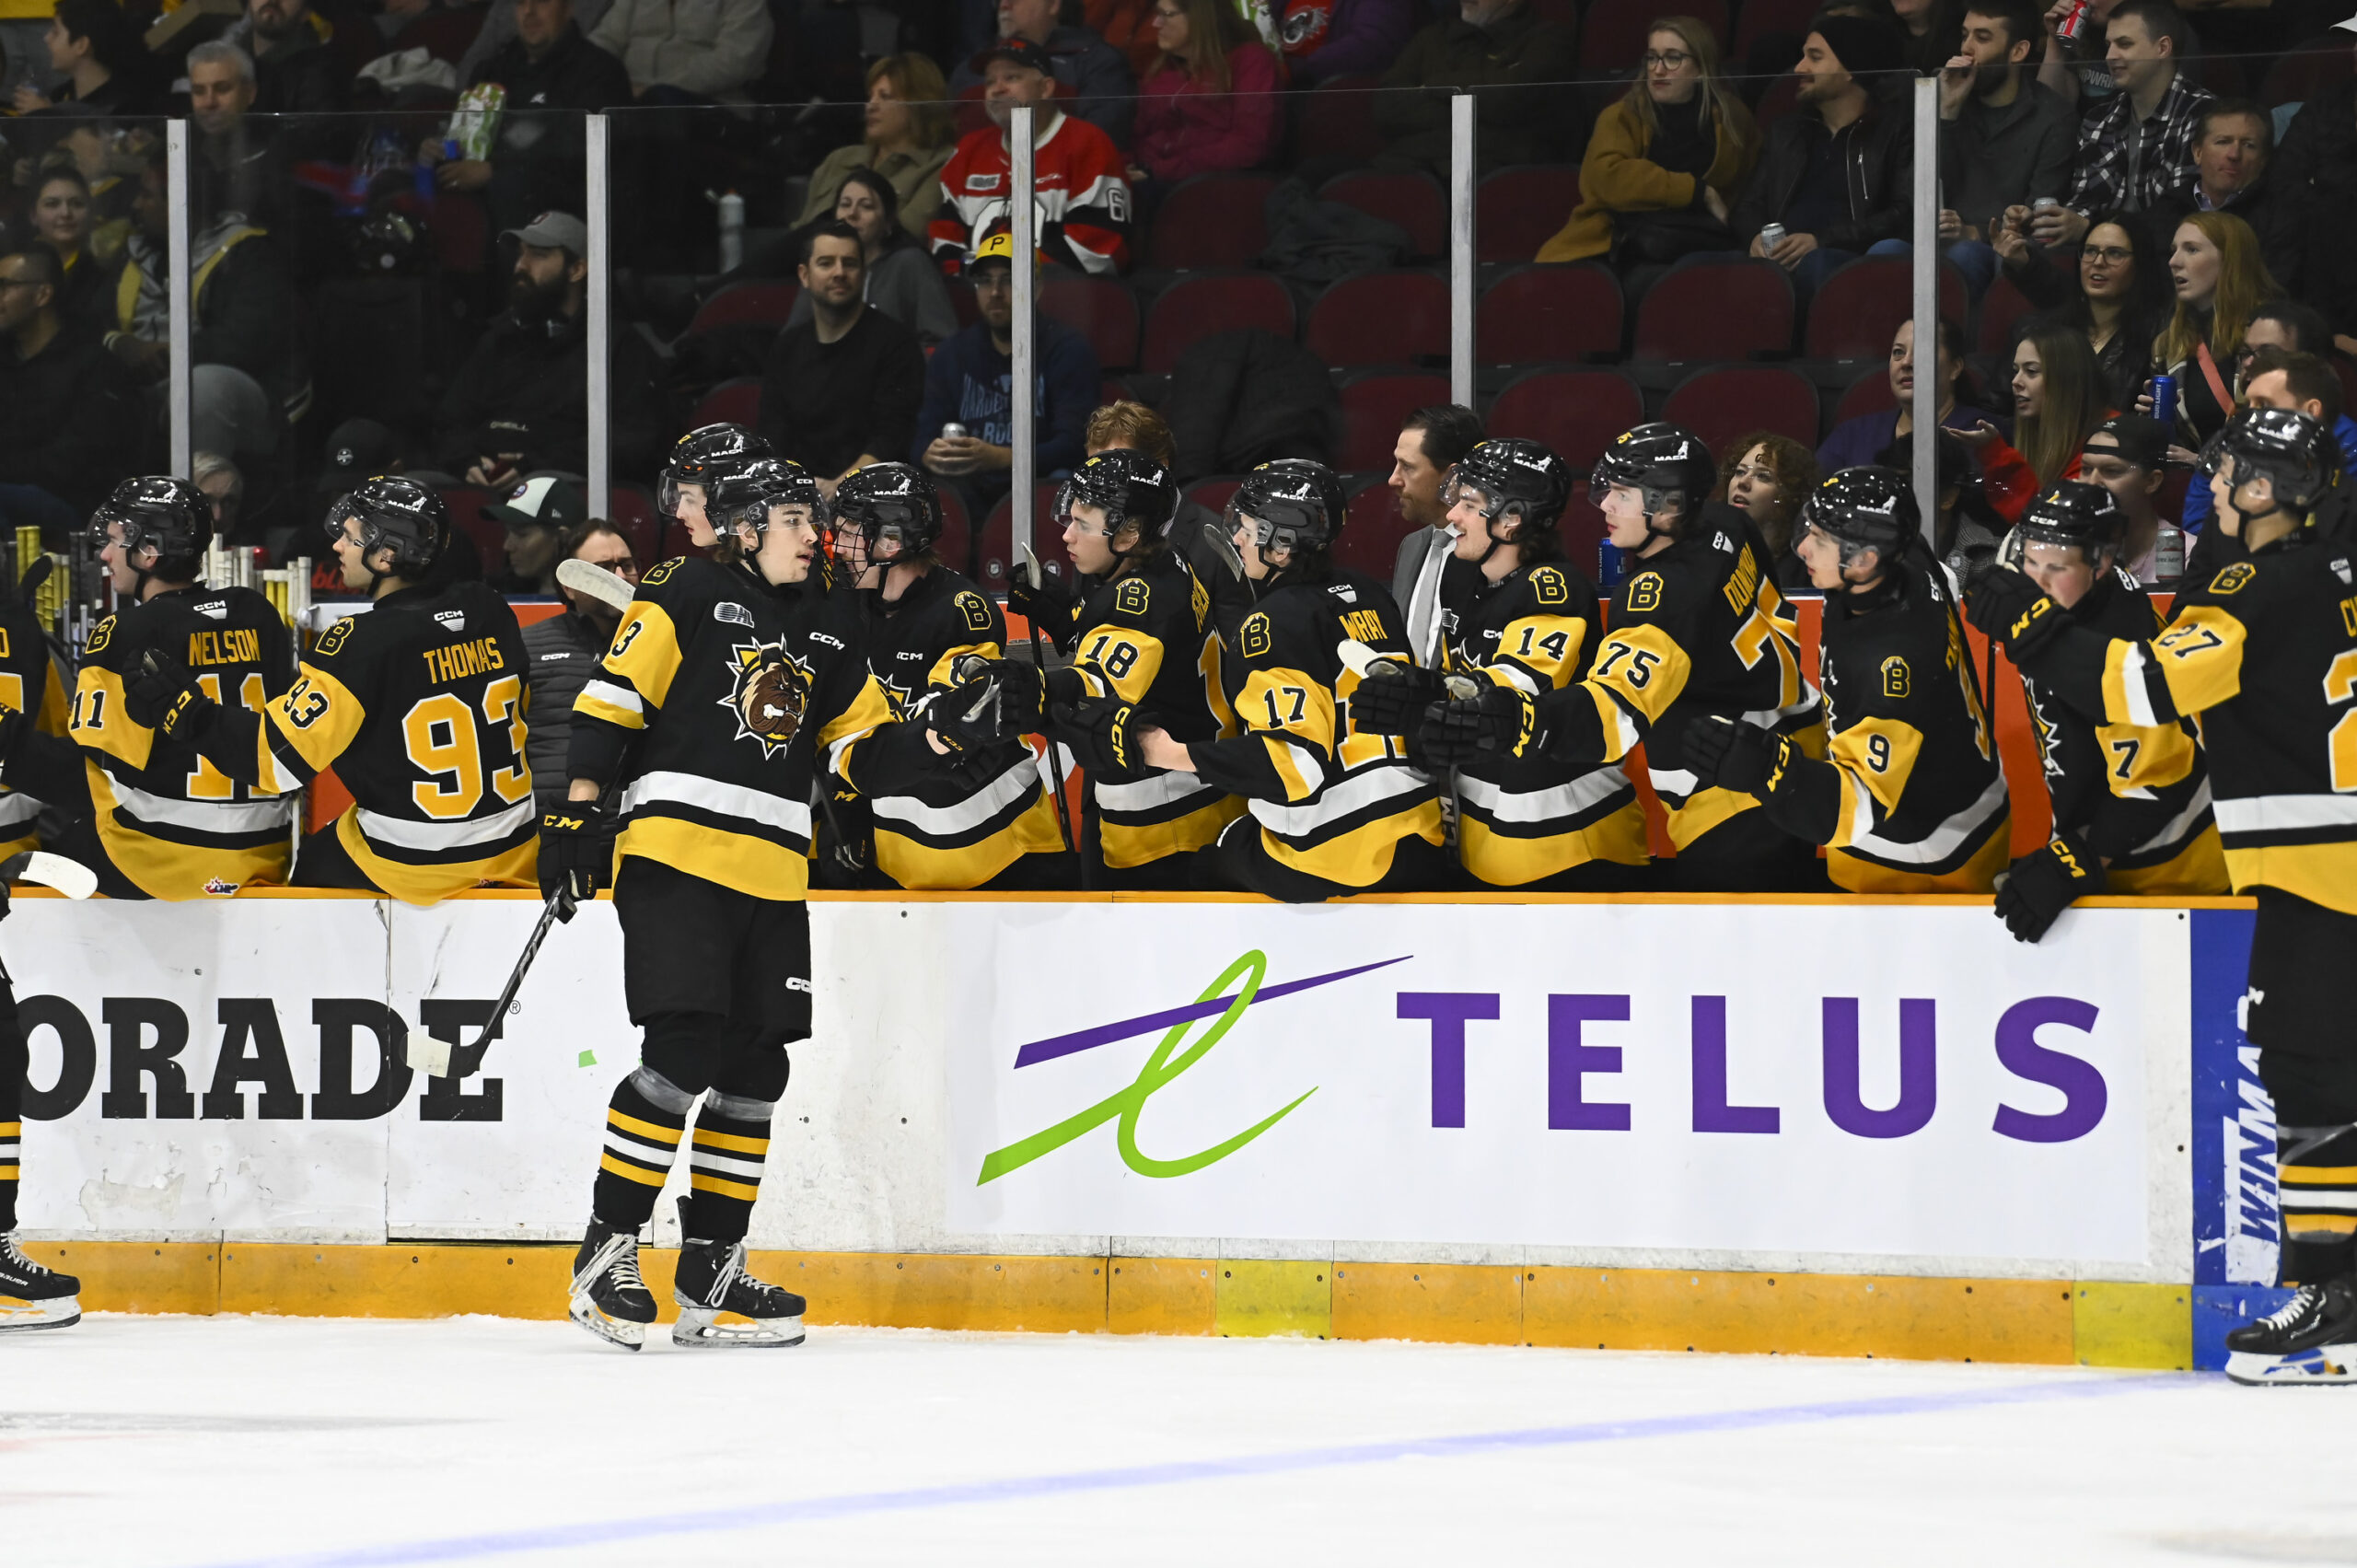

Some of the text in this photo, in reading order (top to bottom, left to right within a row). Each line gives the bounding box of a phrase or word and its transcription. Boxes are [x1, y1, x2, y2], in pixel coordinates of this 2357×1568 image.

[990, 237, 1005, 251] P
[711, 447, 744, 459] MACK
[723, 473, 753, 482] MACK
[1130, 475, 1160, 487] MACK
[139, 495, 173, 505] MACK
[1115, 577, 1151, 616] B
[1327, 583, 1353, 594] CCM
[1527, 565, 1569, 605] B
[1626, 571, 1665, 612] B
[192, 599, 227, 612] CCM
[434, 610, 465, 622] CCM
[954, 590, 993, 631] B
[85, 614, 117, 655] B
[315, 617, 355, 656] B
[610, 621, 643, 658] 3
[808, 631, 846, 651] CCM
[1240, 611, 1271, 658] B
[1338, 609, 1388, 644] WRAY
[1515, 626, 1571, 662] 14
[2156, 621, 2223, 661] 27
[189, 628, 261, 668] NELSON
[423, 636, 505, 686] THOMAS
[540, 653, 571, 662] CCM
[1085, 633, 1141, 680] 18
[1596, 642, 1661, 691] 75
[1880, 656, 1910, 698] B
[69, 689, 107, 730] 11
[283, 678, 331, 729] 93
[1262, 685, 1307, 730] 17
[402, 674, 534, 819] 93
[1110, 706, 1132, 770] CCM
[1866, 733, 1892, 775] 9
[2112, 738, 2141, 780] 7
[1396, 992, 2108, 1144] TELUS
[2236, 994, 2279, 1243] WINMA
